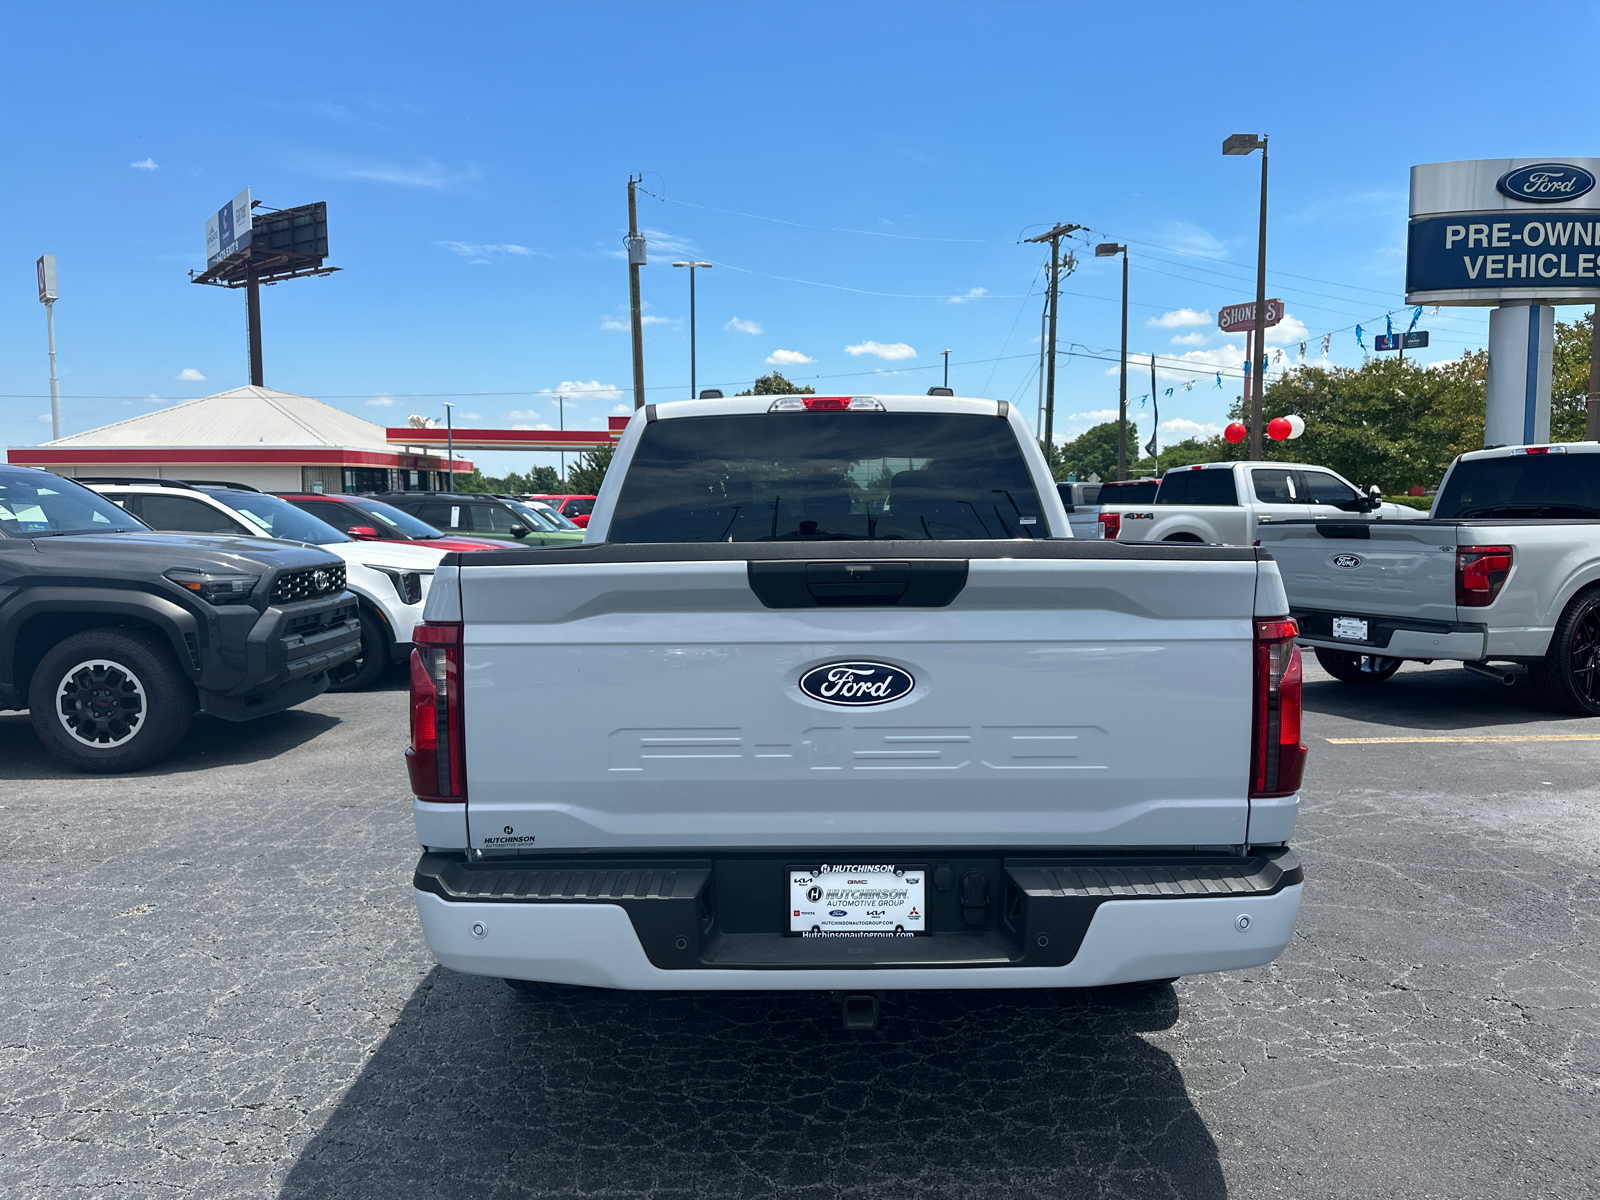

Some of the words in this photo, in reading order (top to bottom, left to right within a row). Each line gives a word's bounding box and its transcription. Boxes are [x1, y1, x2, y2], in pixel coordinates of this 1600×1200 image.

[1523, 171, 1577, 193] Ford
[1445, 221, 1600, 250] PRE-OWN
[1463, 253, 1600, 280] VEHICLE
[1336, 557, 1356, 567] Ford
[819, 667, 894, 698] Ford
[484, 835, 536, 844] HUTCHINSON
[832, 864, 895, 873] HUTCHINSON
[825, 888, 908, 900] HUTCHINSON
[826, 899, 876, 907] AUTOMOTIVE
[878, 899, 905, 907] GROUP
